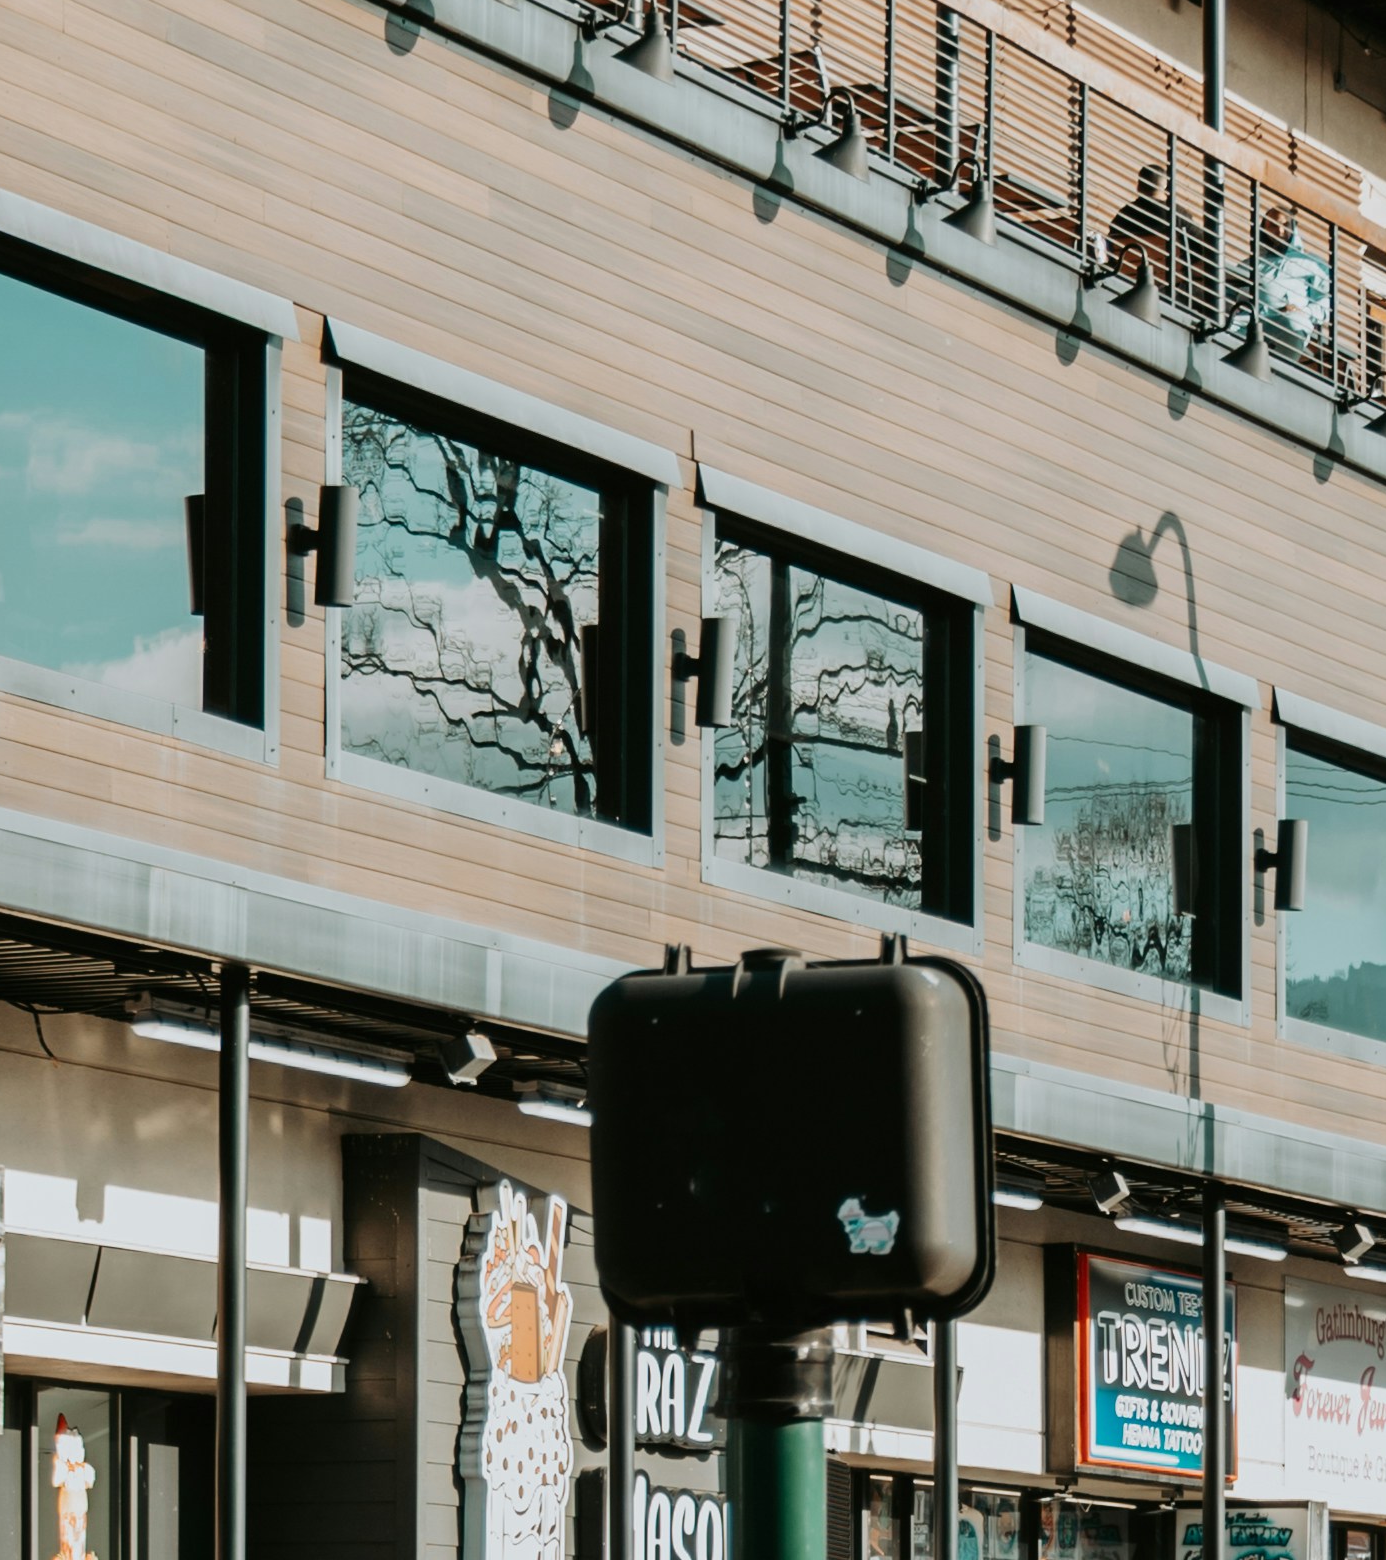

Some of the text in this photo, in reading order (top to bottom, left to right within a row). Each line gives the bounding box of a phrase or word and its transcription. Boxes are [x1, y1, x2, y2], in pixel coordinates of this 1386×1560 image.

[1125, 1281, 1176, 1314] CUSTOM
[1097, 1310, 1232, 1402] TREN
[635, 1351, 715, 1442] RAZ
[1292, 1351, 1352, 1426] Forever
[1115, 1394, 1204, 1429] GIFTS & SOUVEN
[1122, 1423, 1204, 1456] HENNA TATTOO
[1307, 1445, 1360, 1484] Boutique
